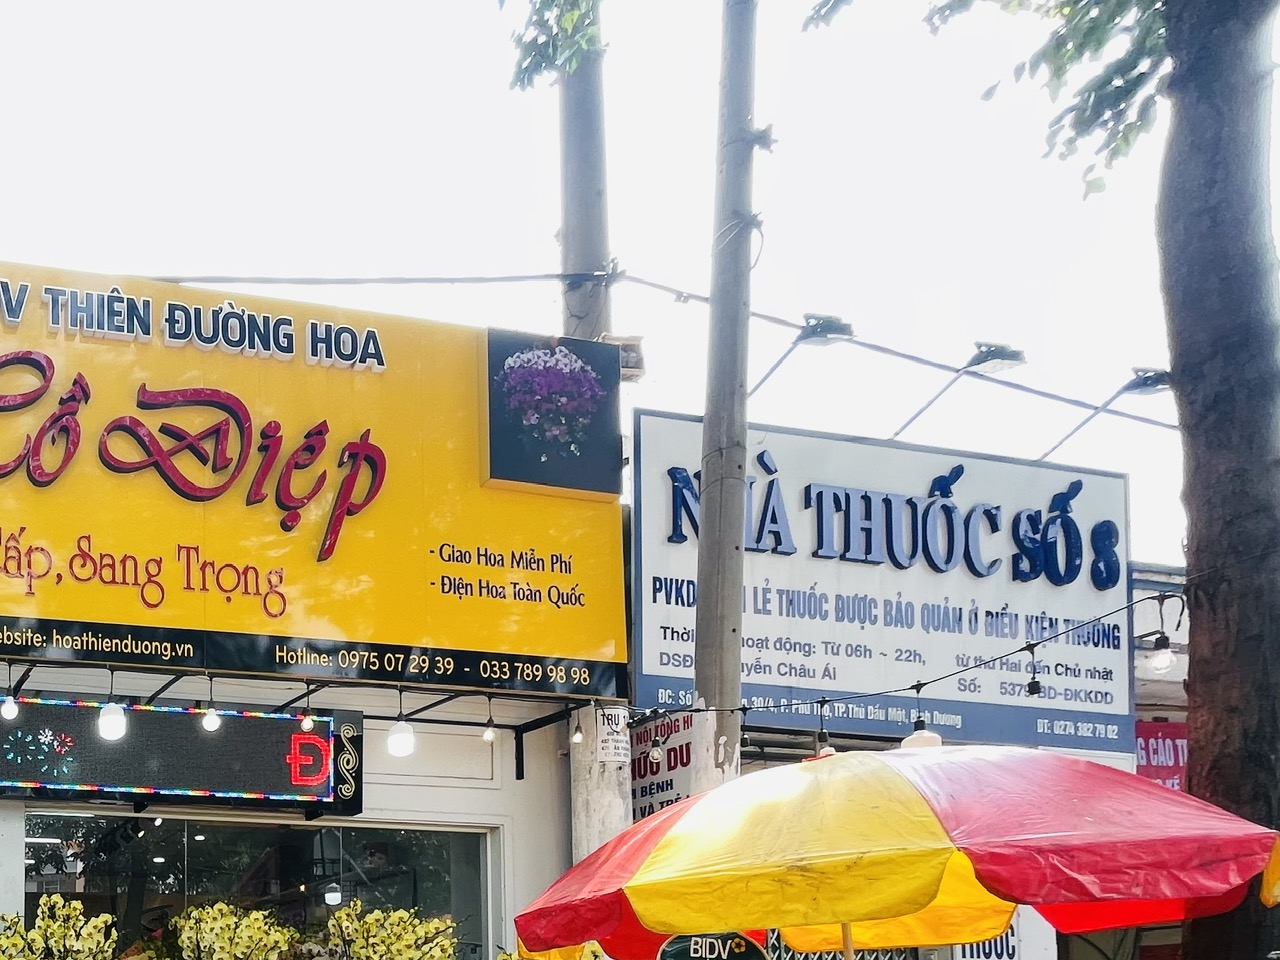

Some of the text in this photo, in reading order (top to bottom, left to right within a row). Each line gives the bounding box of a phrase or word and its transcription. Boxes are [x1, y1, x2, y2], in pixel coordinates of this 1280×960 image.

[43, 286, 153, 341] THIÊN
[164, 299, 295, 357] ĐƯỜNG
[306, 319, 387, 371] HOA
[98, 383, 387, 562] Điệp
[804, 463, 1002, 579] THUỐC
[1012, 479, 1083, 587] SỐ
[1090, 519, 1121, 592] 8
[69, 534, 165, 609] Sang
[177, 544, 287, 618] Trọng
[439, 543, 573, 575] Giao Hoa Miễn Phí
[441, 575, 586, 609] Điện Hoa Toàn Quốc
[652, 576, 696, 608] PVKD
[753, 577, 772, 615] LẺ
[776, 581, 829, 621] THUỐC
[883, 591, 915, 629] BẢO
[920, 596, 963, 634] QUẢN
[968, 598, 979, 635] Ở
[52, 629, 194, 659] hoathienduong.vn
[660, 626, 695, 643] Thời
[773, 637, 816, 658] động:
[821, 640, 842, 657] Từ
[845, 643, 872, 659] 06h
[894, 648, 926, 666] 22h,
[999, 657, 1021, 672] Hai
[1054, 662, 1081, 679] Chủ
[1084, 666, 1114, 684] nhật
[276, 645, 591, 687] Hotline: 0975 07 29 39 033 789 98 98
[659, 652, 837, 680] DSĐ Châu Ái
[658, 689, 675, 704] ĐC:
[679, 689, 693, 706] Số
[957, 677, 981, 693] Số:
[286, 733, 330, 786] Đ
[1148, 732, 1175, 766] CÁO
[641, 778, 673, 799] BỆNH
[690, 937, 732, 960] BIDV
